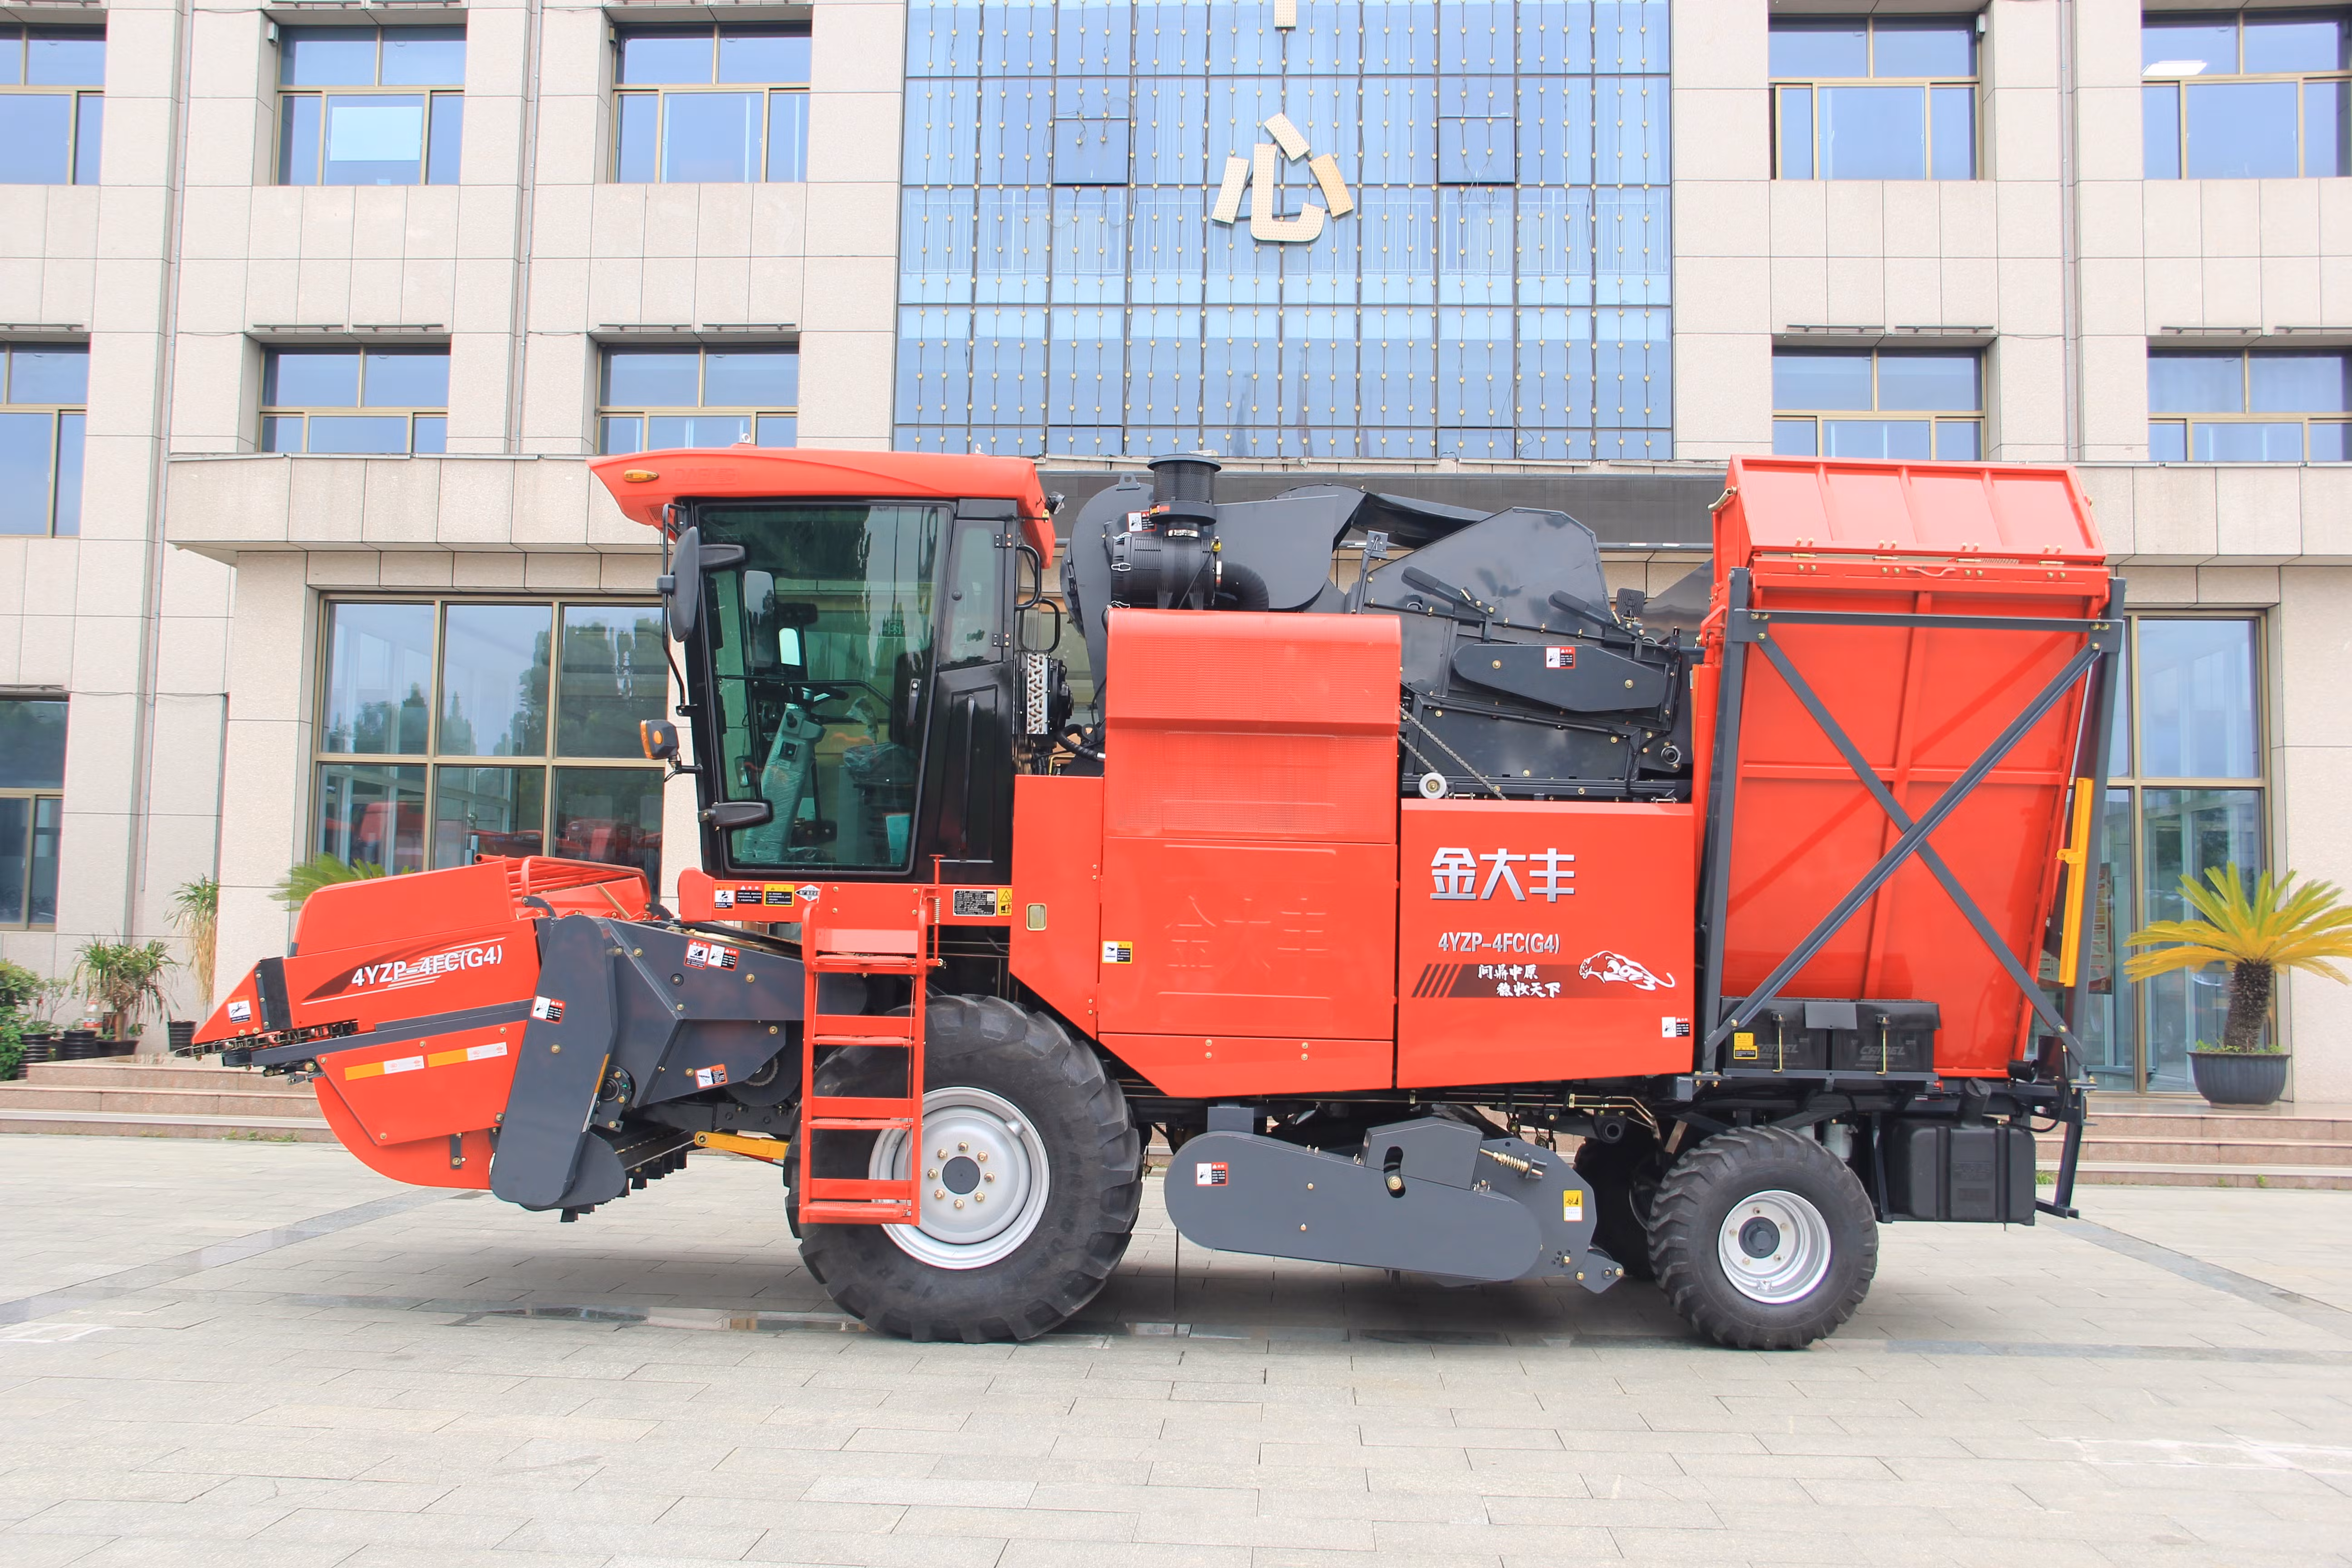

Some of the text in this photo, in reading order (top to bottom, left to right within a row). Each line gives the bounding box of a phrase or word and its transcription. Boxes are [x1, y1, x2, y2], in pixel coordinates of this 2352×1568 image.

[1430, 847, 1576, 902] 金大丰
[1438, 932, 1560, 954] 4YZP-4FC(G4)
[352, 945, 502, 987] 4YZP-4FC(G4)
[1478, 964, 1539, 981] 问鼎中原
[1496, 981, 1561, 998] 稳收天下
